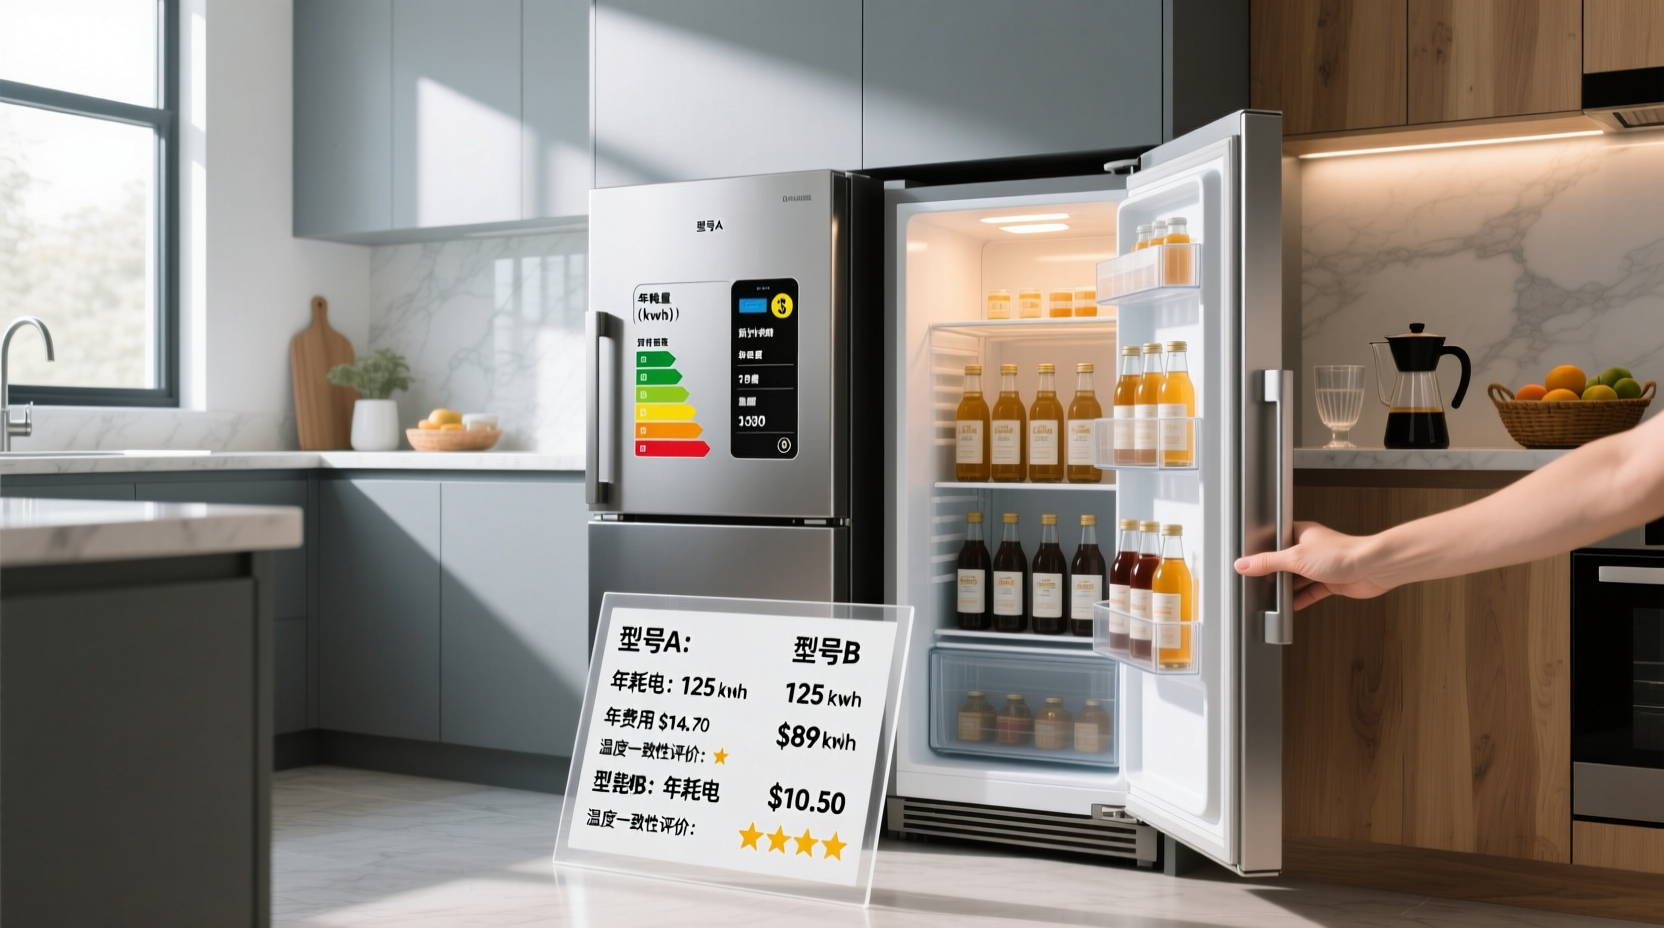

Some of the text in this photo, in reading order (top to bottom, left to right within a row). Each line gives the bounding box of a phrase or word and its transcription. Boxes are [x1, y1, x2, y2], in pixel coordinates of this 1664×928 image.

[617, 625, 691, 655] 型号A:
[791, 635, 861, 666] 型号B
[786, 682, 825, 706] 125
[603, 706, 710, 733] 年费用 $14.70
[775, 721, 821, 751] $89
[662, 775, 720, 804] 年耗电
[767, 781, 846, 815] $10.50
